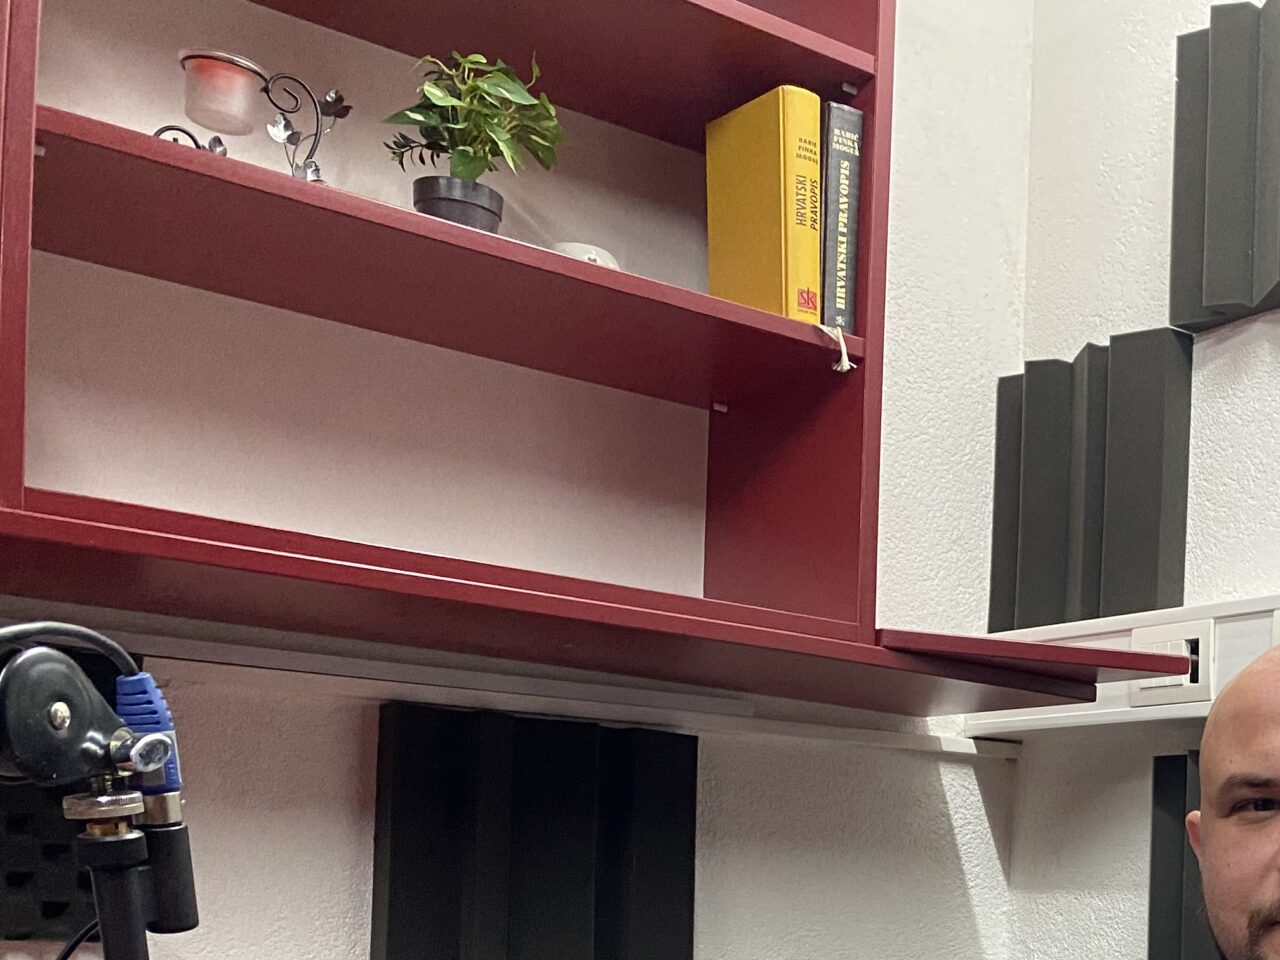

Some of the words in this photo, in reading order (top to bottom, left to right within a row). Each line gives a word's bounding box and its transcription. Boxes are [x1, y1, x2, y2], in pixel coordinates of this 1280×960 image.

[795, 174, 807, 227] HRVATSKI
[810, 178, 818, 231] PRAVOPIS
[838, 160, 851, 234] PRAVOPIS
[835, 235, 848, 310] HRVATSKI
